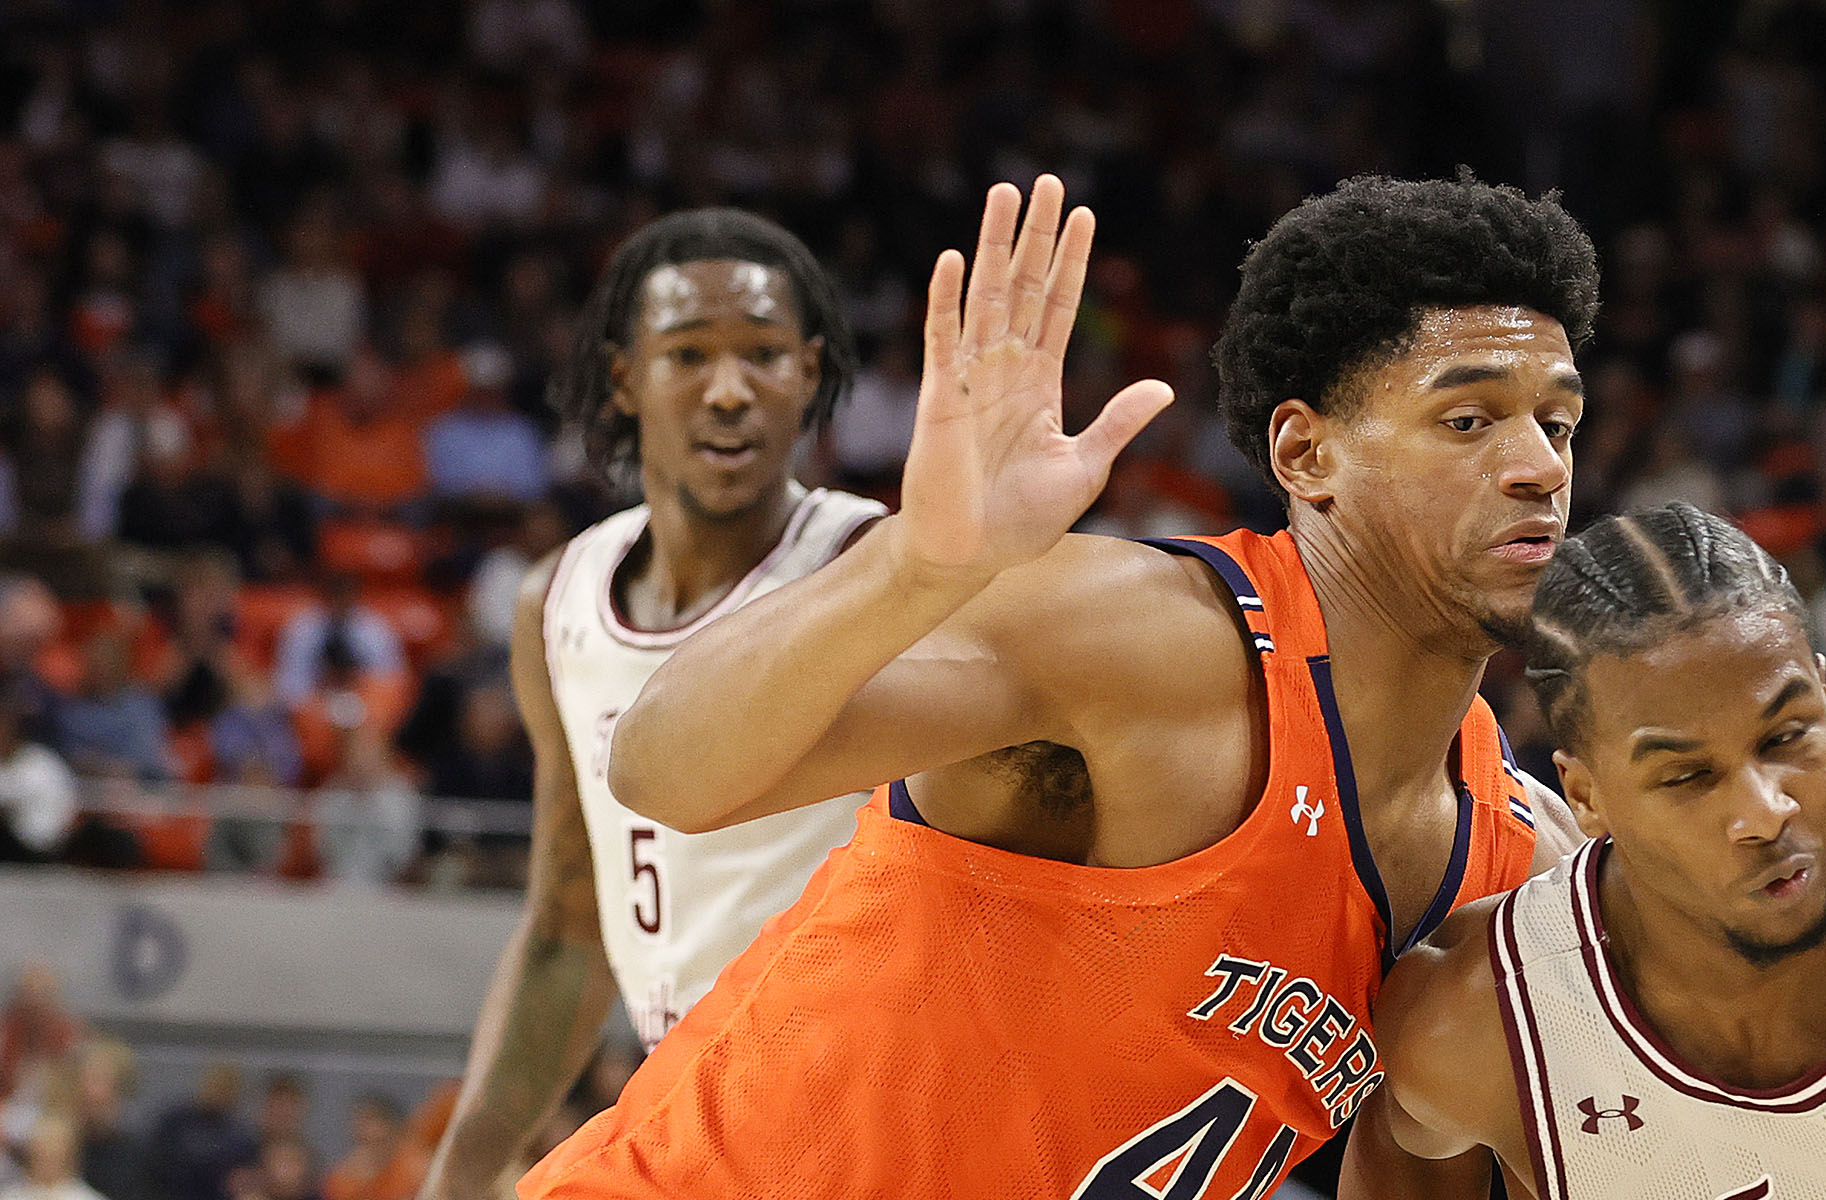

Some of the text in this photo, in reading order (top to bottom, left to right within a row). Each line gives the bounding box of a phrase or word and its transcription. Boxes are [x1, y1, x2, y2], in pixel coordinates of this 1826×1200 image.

[630, 827, 662, 934] 5
[112, 902, 192, 1001] D
[1187, 953, 1386, 1129] TIGERS
